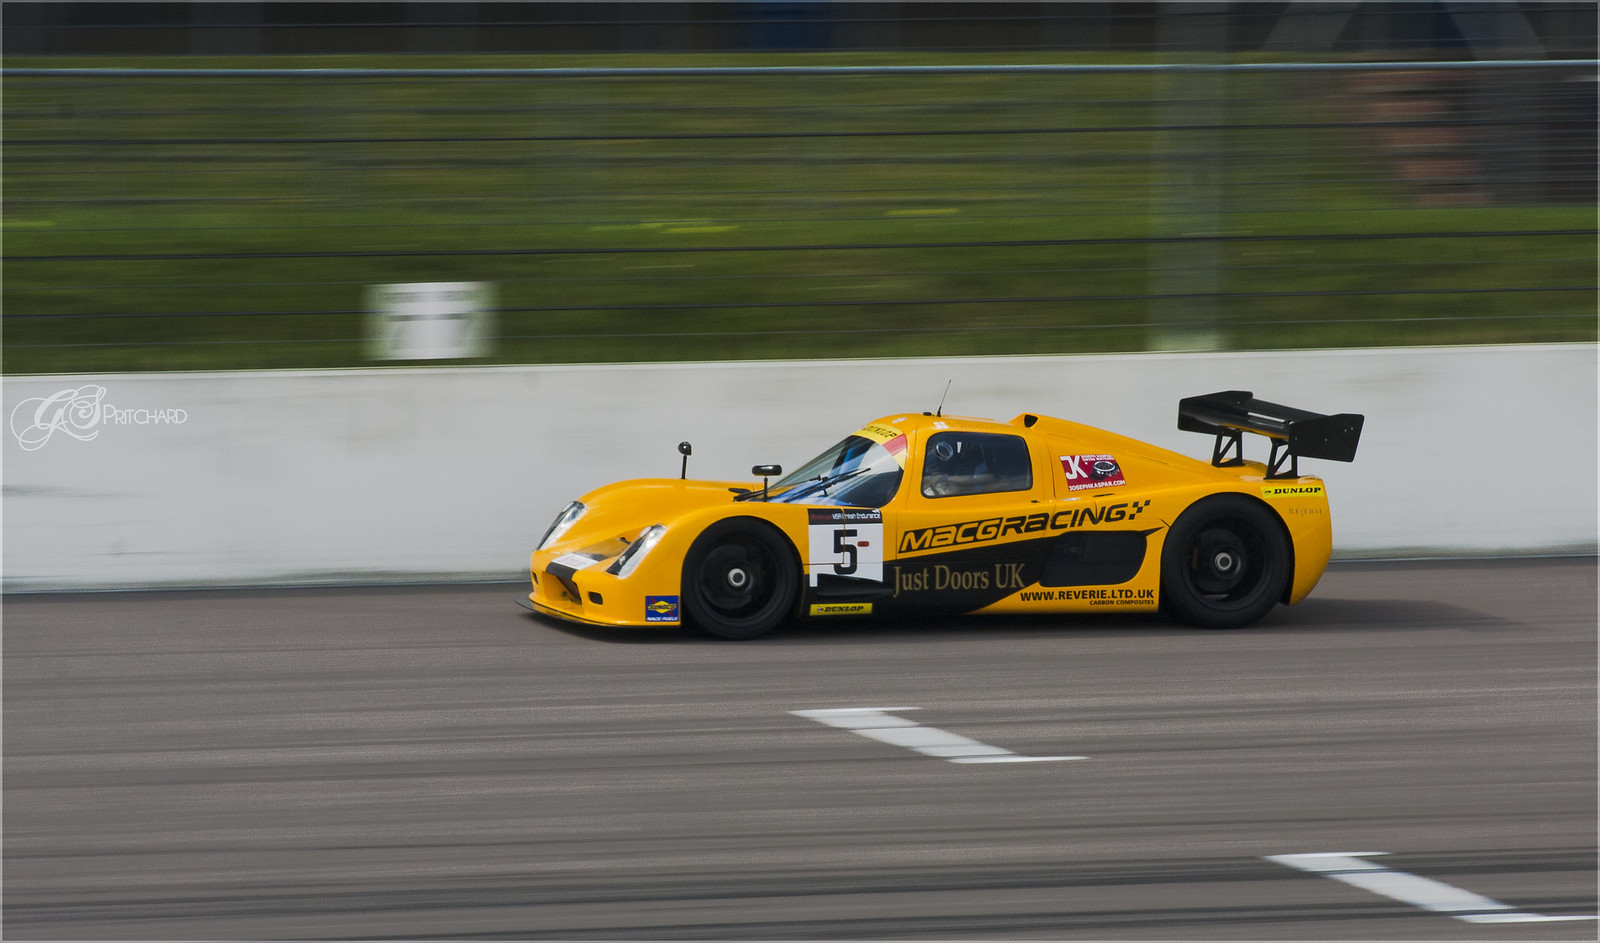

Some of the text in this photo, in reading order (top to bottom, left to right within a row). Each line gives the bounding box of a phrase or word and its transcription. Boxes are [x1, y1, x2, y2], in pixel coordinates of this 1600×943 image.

[833, 529, 857, 575] 5
[893, 563, 1026, 598] Just Doors UK
[1020, 589, 1155, 601] WWW.REVERIE.LTD.UK
